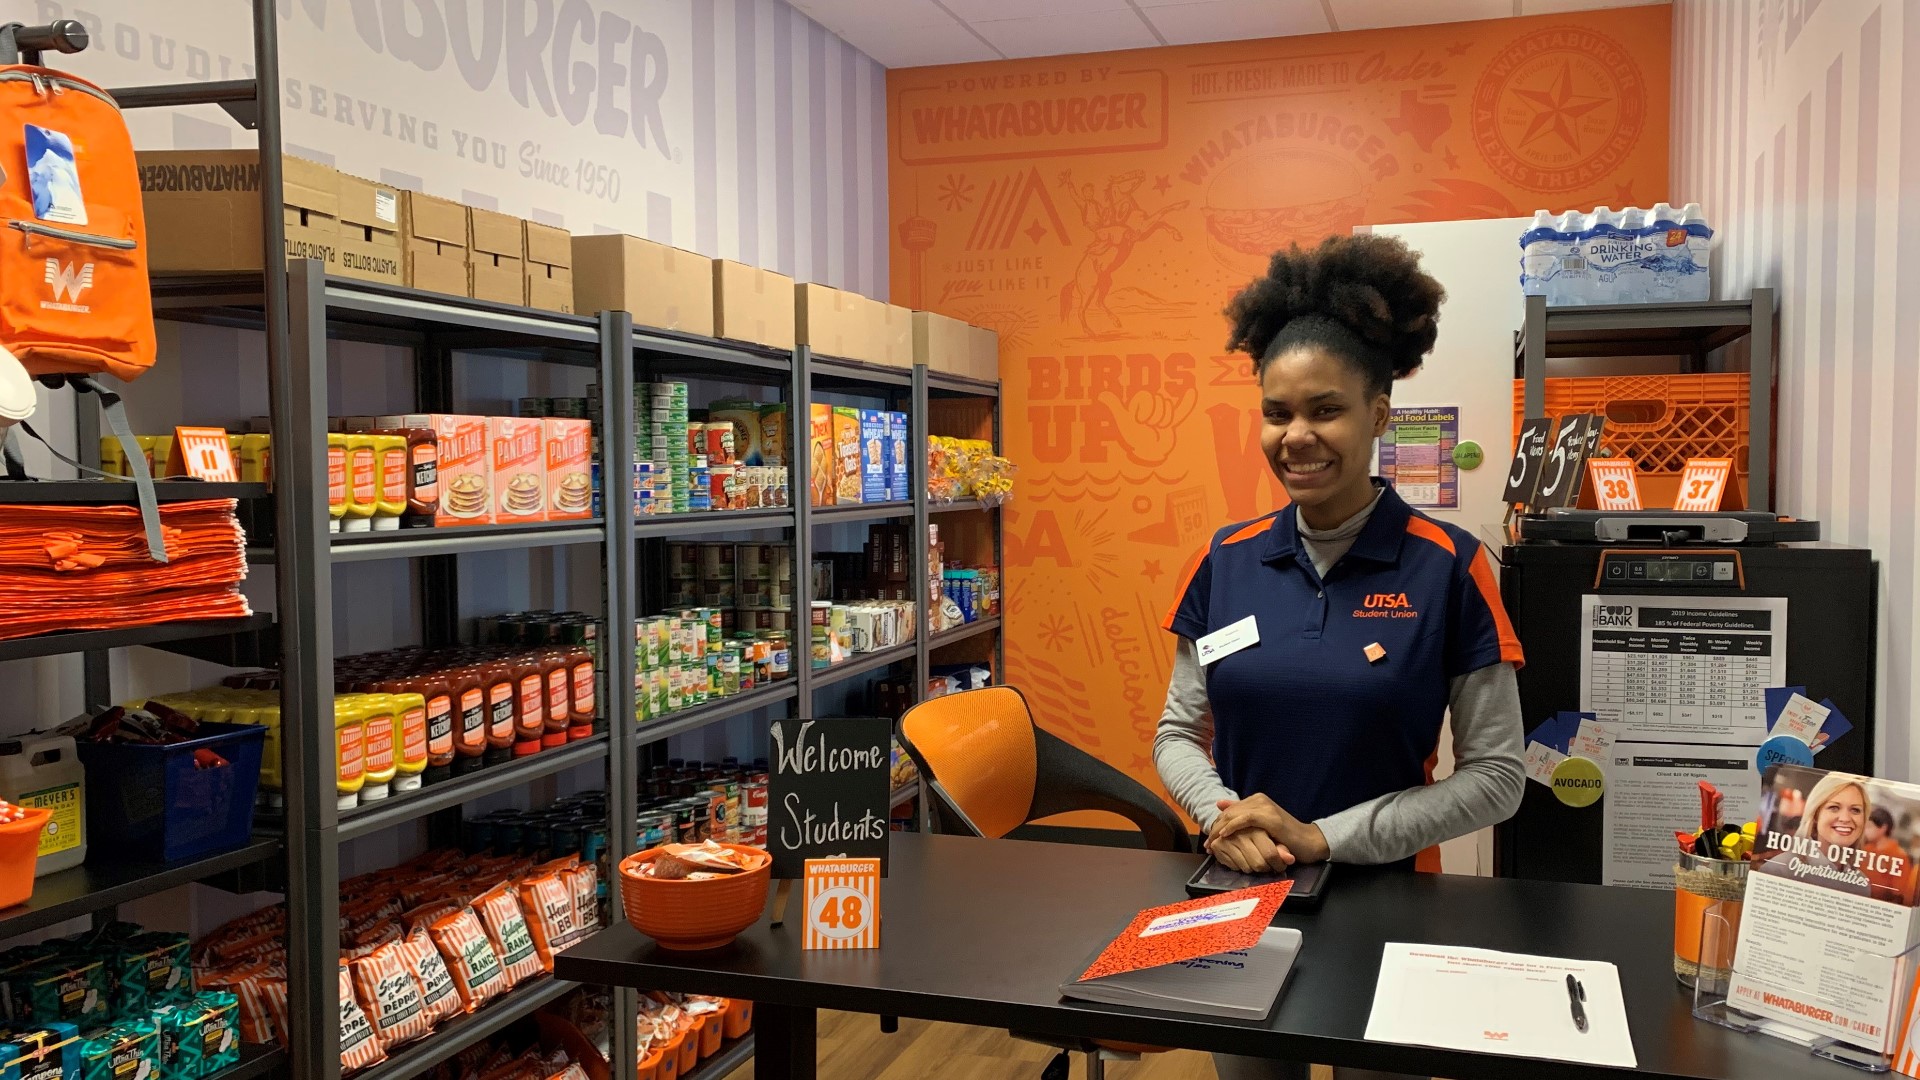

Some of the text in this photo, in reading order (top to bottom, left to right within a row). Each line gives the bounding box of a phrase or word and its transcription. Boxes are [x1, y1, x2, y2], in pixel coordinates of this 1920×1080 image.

[1282, 63, 1323, 86] MADE
[1331, 61, 1350, 84] TO
[1354, 50, 1447, 86] Order
[1491, 32, 1636, 89] WHATABURGER
[945, 67, 1112, 93] POWERED BY
[285, 77, 439, 150] SERVING
[451, 128, 507, 169] YOU
[911, 92, 1148, 145] WHATABURGER
[1179, 112, 1400, 186] WHATABURGER
[1478, 129, 1529, 182] TEXAS
[1535, 123, 1636, 188] TREASURE
[518, 139, 622, 204] Since 1950
[1590, 242, 1653, 255] DRINKING
[1669, 231, 1683, 242] 24
[285, 238, 335, 263] PLASTIC BOTTL
[1601, 251, 1642, 263] WATER
[343, 251, 398, 276] PLASTIC BOTTLES
[956, 256, 1043, 274] JUST LIKE
[989, 277, 1026, 292] LIKE
[1035, 275, 1051, 290] IT
[1027, 352, 1197, 402] BIRDS
[1402, 408, 1423, 416] Healthy
[1405, 414, 1427, 422] Food
[1428, 413, 1455, 421] Labels
[862, 428, 884, 439] WHEAT
[1027, 404, 1123, 464] UP
[201, 449, 218, 470] 11
[437, 429, 483, 465] PANCAKE
[497, 432, 538, 467] PANCAKE
[551, 431, 589, 467] PANCAKE
[1510, 426, 1537, 488] 5
[1543, 418, 1578, 497] 5
[1603, 480, 1630, 499] 38
[1687, 480, 1715, 500] 37
[1363, 593, 1410, 608] UTSA
[1352, 610, 1418, 619] Student Union
[1599, 616, 1633, 627] BANK
[430, 718, 452, 739] KETCHUP
[770, 720, 886, 775] Welcome
[1554, 778, 1602, 789] AVOCADO
[34, 790, 75, 809] MEYER'S
[780, 792, 886, 850] Students
[1766, 830, 1905, 878] HOME OFFICE
[809, 864, 875, 875] WHATABURGER
[1788, 856, 1869, 888] Opportunities
[557, 916, 572, 934] BB
[819, 895, 863, 930] 48
[506, 932, 530, 954] RANC
[426, 970, 450, 991] PEPPE
[383, 990, 417, 1015] PEPPER
[340, 1015, 368, 1038] EPPE
